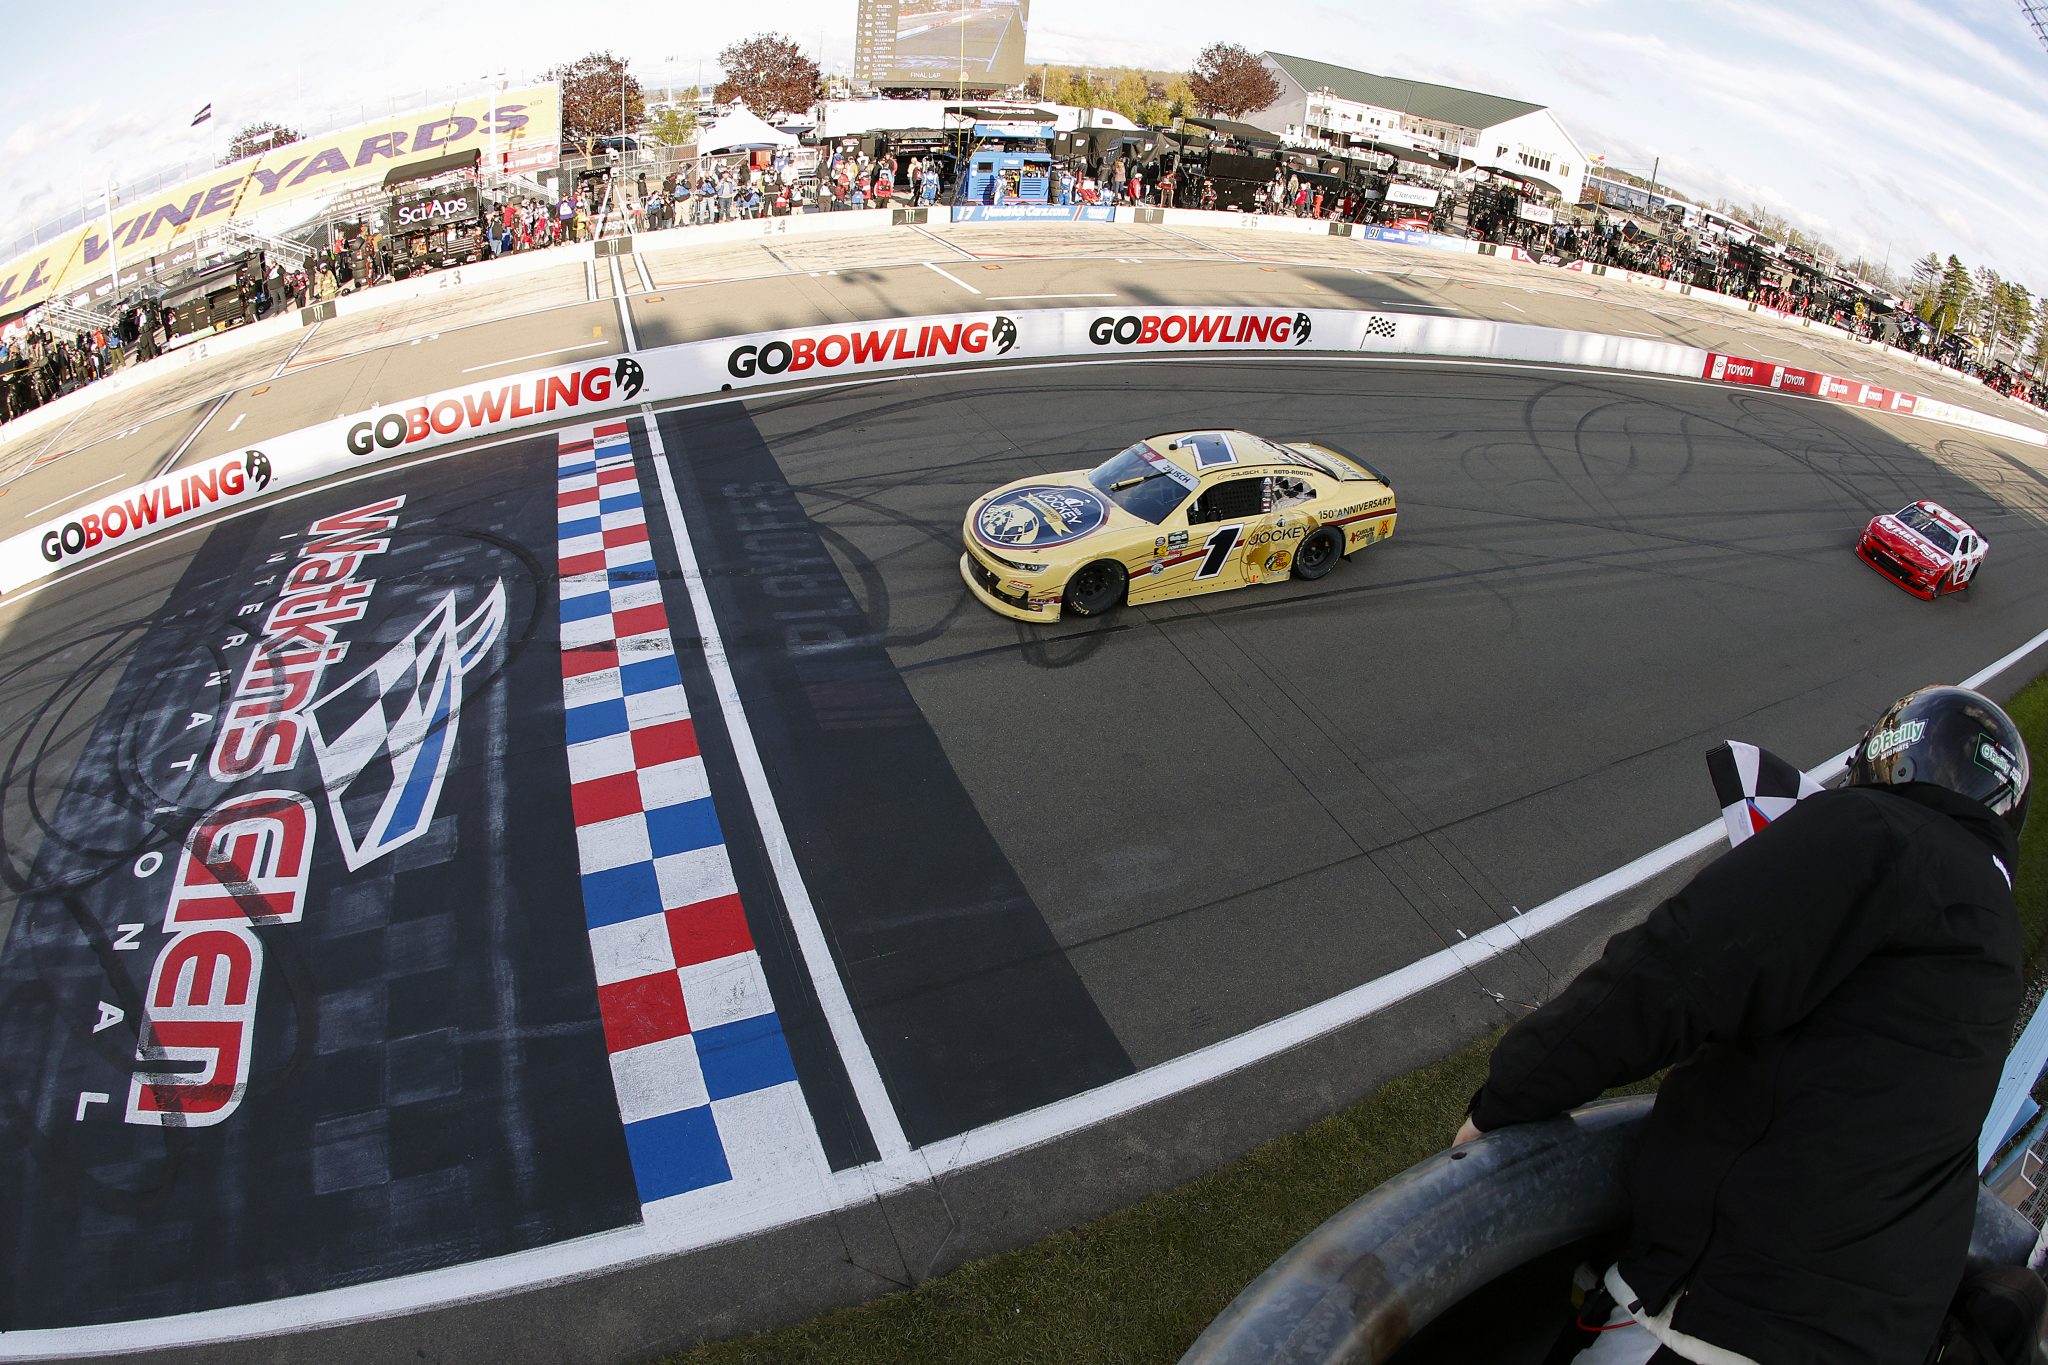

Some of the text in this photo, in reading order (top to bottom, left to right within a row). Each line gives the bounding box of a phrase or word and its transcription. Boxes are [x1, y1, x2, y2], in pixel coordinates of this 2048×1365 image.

[84, 104, 529, 265] VINEYARDS
[352, 190, 363, 200] so
[398, 197, 468, 226] SciAps
[957, 207, 975, 220] 17
[1367, 227, 1380, 239] 91
[1727, 363, 1754, 377] TOYOTA
[1783, 373, 1806, 387] TOYOTA
[1829, 381, 1848, 395] TOYOTA
[1867, 389, 1883, 402] TOYOTA
[1175, 432, 1239, 471] 1
[1163, 464, 1191, 484] ZILISCH
[1273, 469, 1314, 478] ROTO-ROOTER
[1039, 492, 1082, 525] JOCKEY
[1337, 496, 1393, 518] ANNIVERSARY
[1248, 525, 1311, 546] JOCKEY
[1355, 526, 1376, 537] CAROLINA
[1879, 516, 1950, 567] WHELEN
[1192, 522, 1245, 582] 1
[1955, 557, 1968, 583] 2
[1867, 720, 1926, 760] O'Reilly
[1880, 742, 1909, 761] AUTO PARTS
[1981, 743, 2011, 775] O'Reilly
